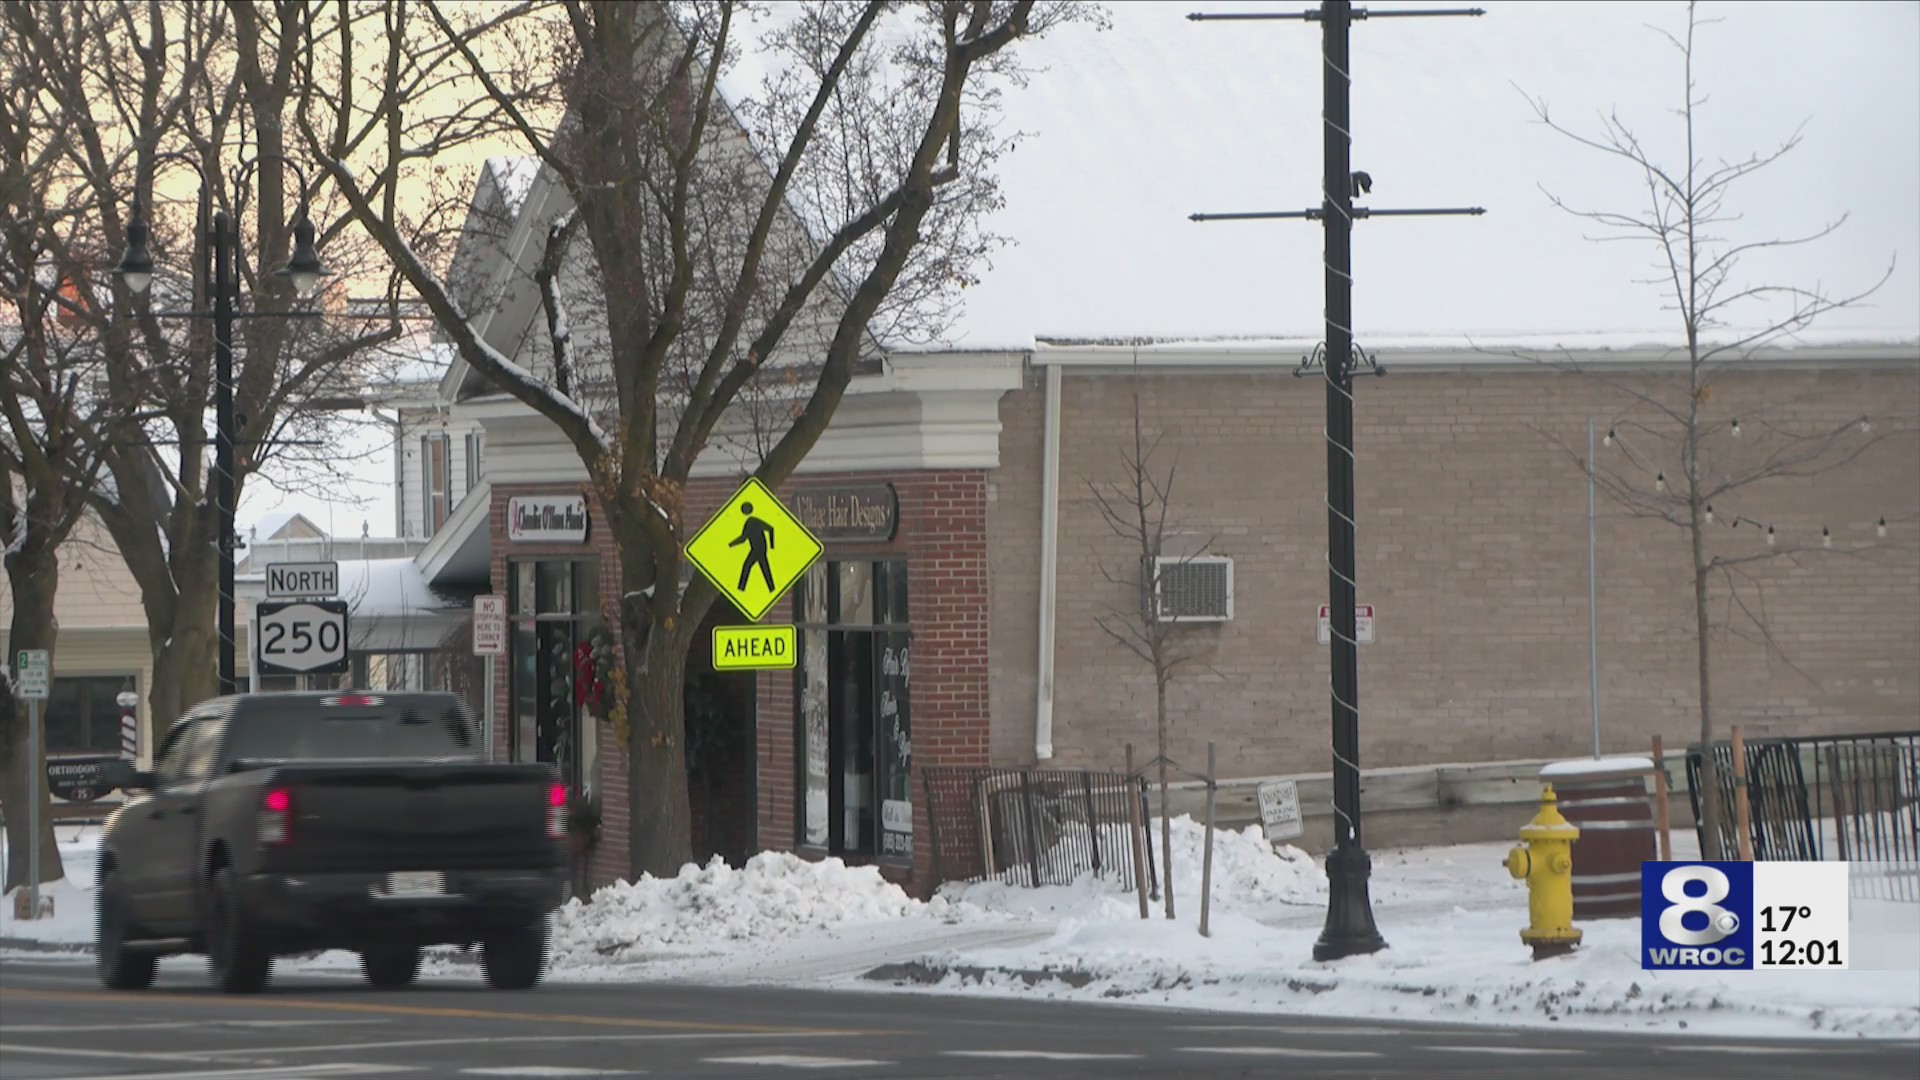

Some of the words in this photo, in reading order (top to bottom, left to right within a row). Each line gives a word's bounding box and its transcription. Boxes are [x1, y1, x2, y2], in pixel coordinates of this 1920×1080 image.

[827, 495, 848, 527] Hair
[850, 495, 886, 534] Designs
[271, 569, 333, 592] NORTH
[483, 601, 496, 613] NO
[264, 621, 340, 654] 250
[476, 623, 491, 632] HERE
[493, 623, 501, 632] TO
[476, 633, 500, 641] CORNER
[724, 637, 786, 657] AHEAD
